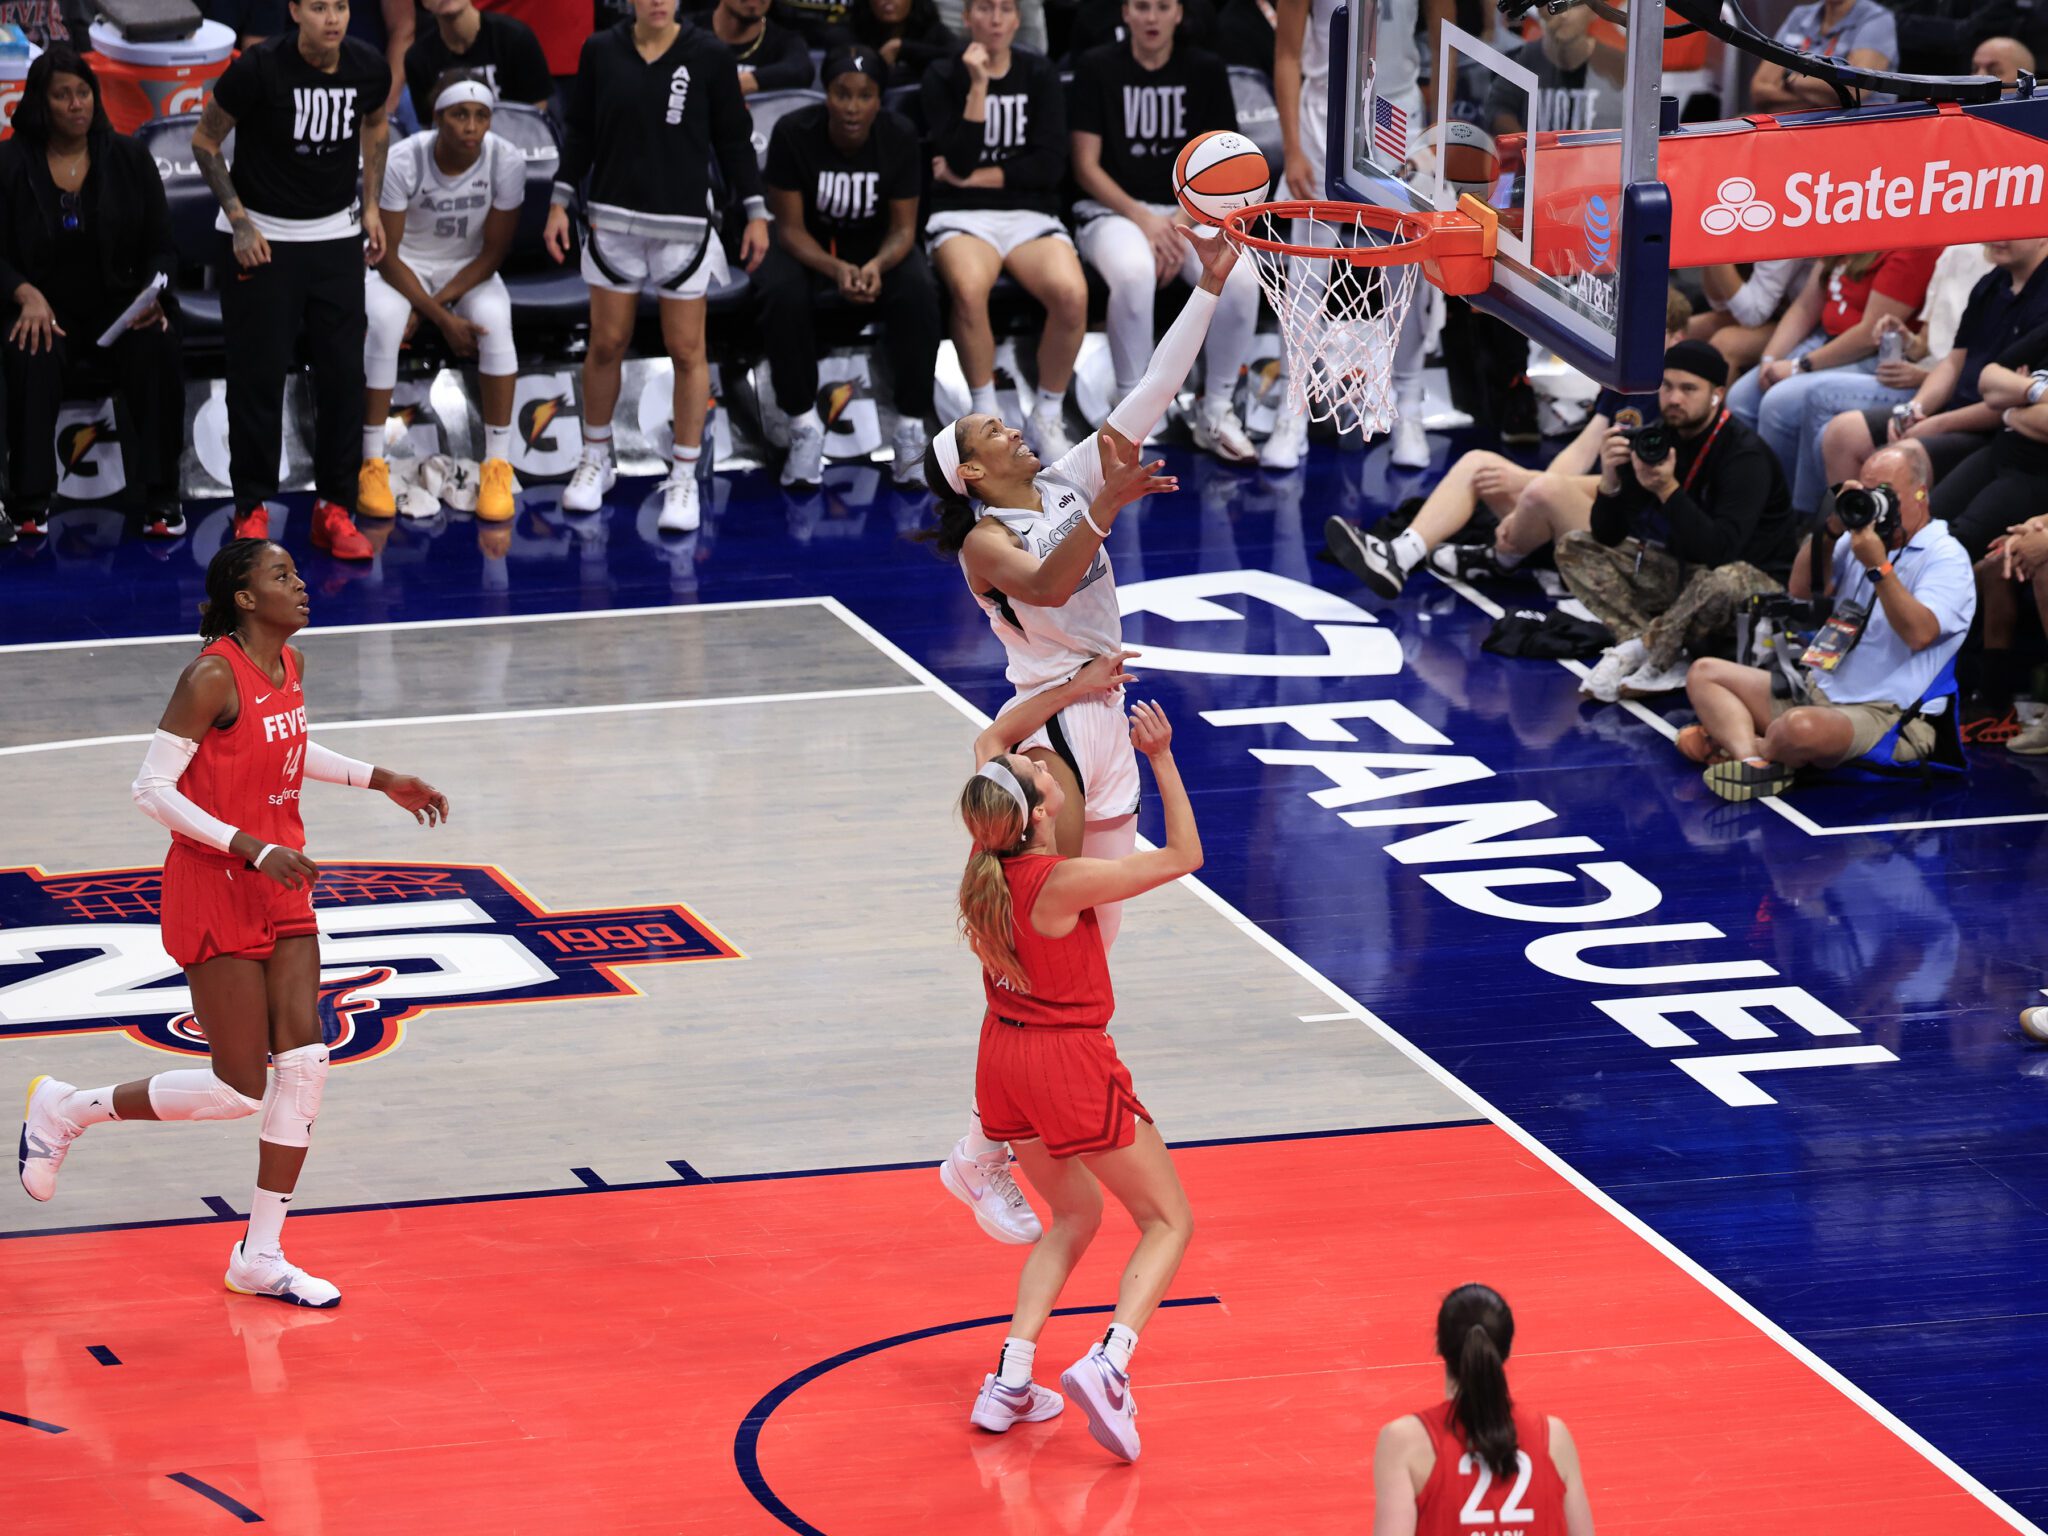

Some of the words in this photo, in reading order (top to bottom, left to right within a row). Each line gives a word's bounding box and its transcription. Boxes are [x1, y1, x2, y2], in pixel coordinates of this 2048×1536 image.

[294, 87, 357, 142] VOTE
[666, 65, 690, 124] ACES
[1123, 85, 1187, 139] VOTE
[983, 93, 1028, 147] OTE
[418, 195, 486, 213] ACES
[816, 171, 880, 219] VOTE
[1782, 166, 1914, 228] State
[1918, 159, 2045, 215] Farm
[433, 215, 469, 239] 51
[1578, 269, 1613, 313] AT&T
[1058, 492, 1077, 509] ally
[1071, 551, 1107, 595] 2
[263, 705, 307, 743] FEVE
[282, 743, 303, 782] 14
[1198, 699, 1901, 1107] FANDUEL
[537, 923, 687, 953] 1999
[1458, 1449, 1535, 1525] 22
